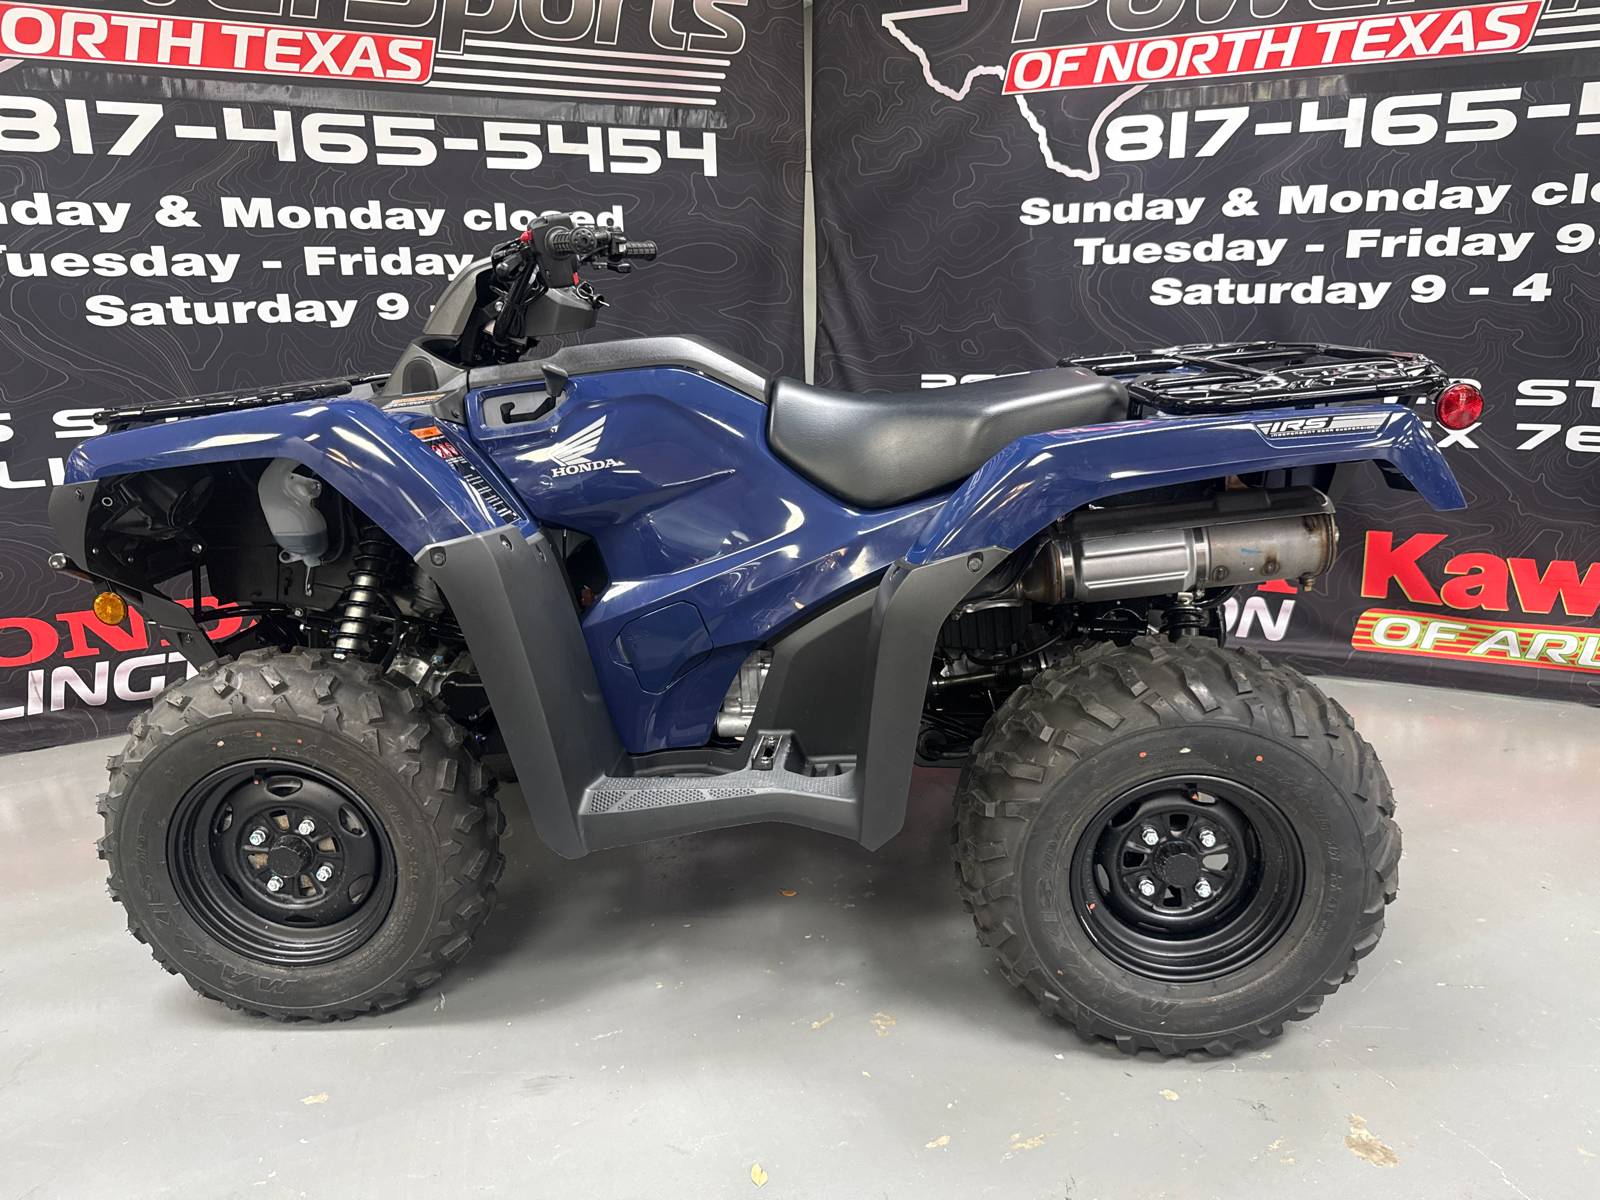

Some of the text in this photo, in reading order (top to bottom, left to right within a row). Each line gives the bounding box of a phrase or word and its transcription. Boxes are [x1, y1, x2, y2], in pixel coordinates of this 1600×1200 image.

[221, 25, 422, 80] TEXAS
[1014, 48, 1088, 90] OF
[1093, 26, 1303, 83] NORTH
[1316, 5, 1528, 64] TEXAS
[0, 95, 718, 177] 817-465-5454
[0, 193, 131, 233] day
[155, 195, 202, 228] &
[221, 197, 445, 236] Monday
[1019, 193, 1206, 225] Sunday
[1222, 187, 1260, 217] &
[1278, 180, 1512, 215] Monday
[0, 244, 240, 283] uesday
[304, 246, 474, 281] Friday
[1073, 233, 1288, 267] Tuesday
[1346, 226, 1535, 261] Friday
[86, 292, 409, 328] Saturday 9
[1149, 275, 1392, 310] Saturday
[1410, 274, 1447, 303] 9
[1512, 273, 1552, 302] 4
[1270, 417, 1330, 432] IRS
[551, 458, 619, 477] HONDA
[1361, 530, 1600, 617] Kaw
[1372, 617, 1468, 650] OF
[1035, 878, 1180, 1017] MAXXIS
